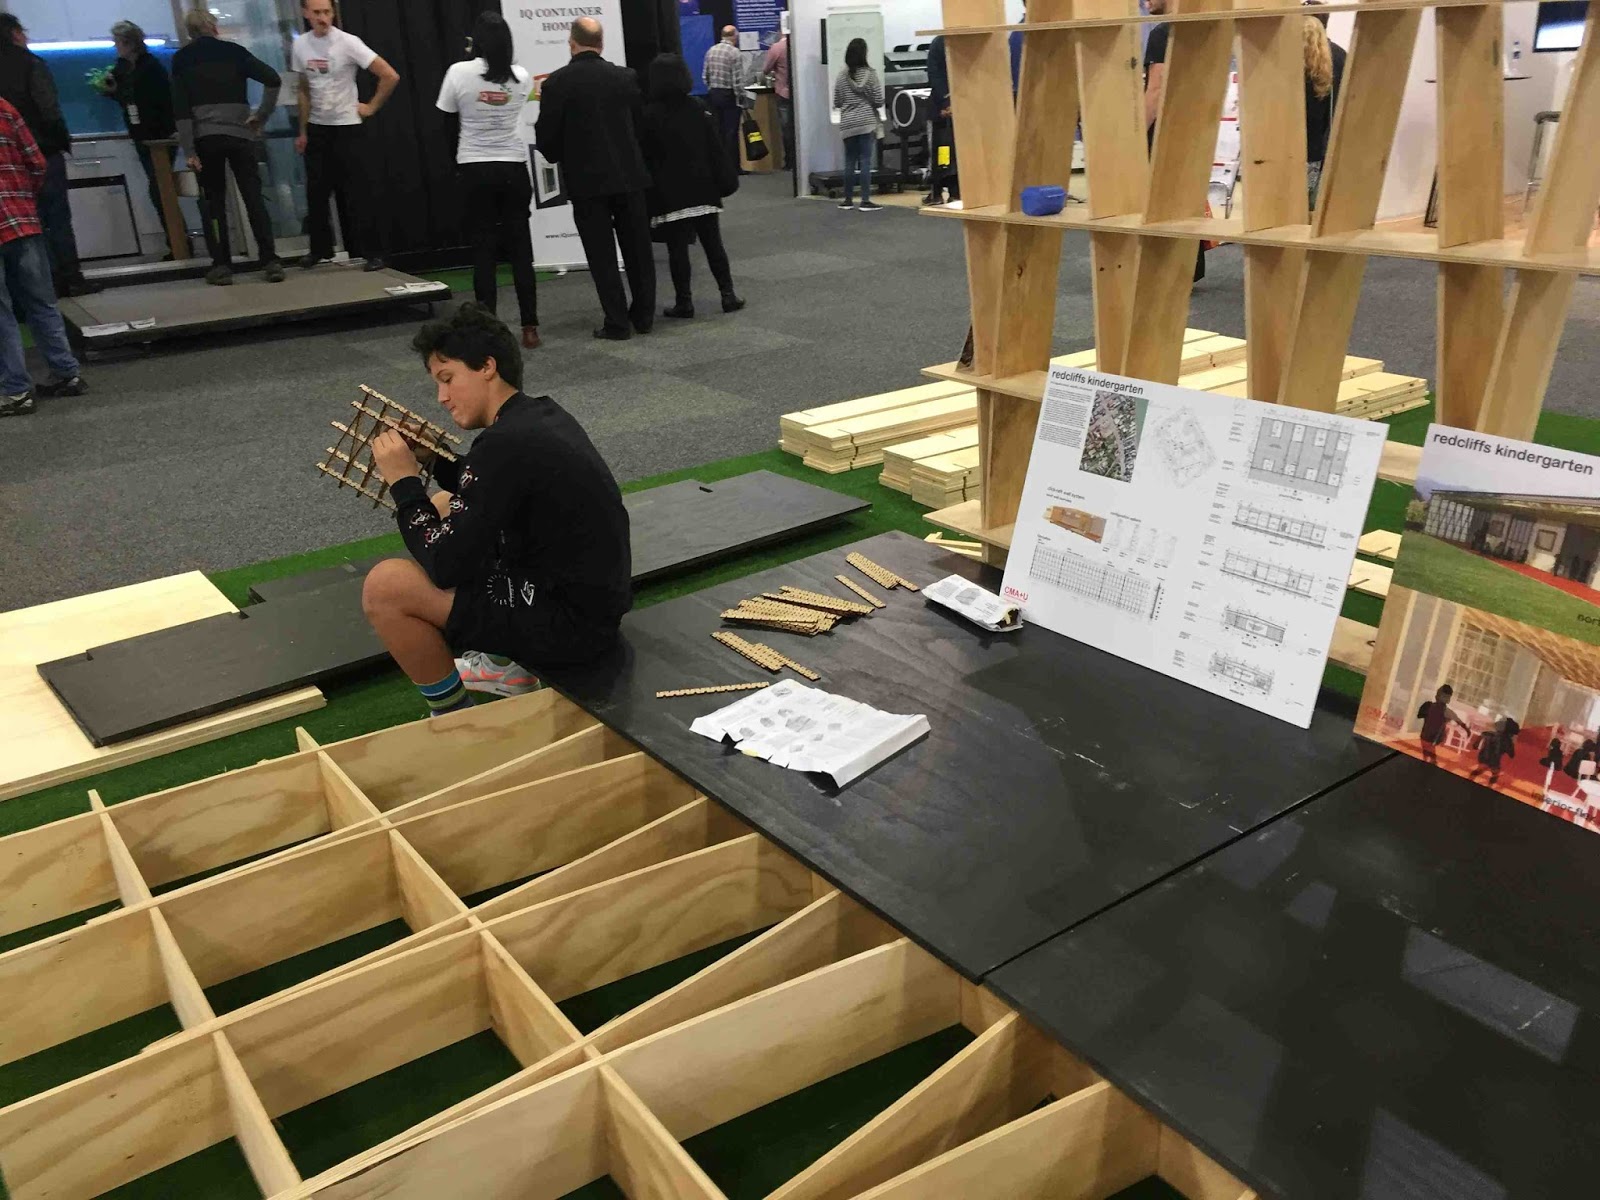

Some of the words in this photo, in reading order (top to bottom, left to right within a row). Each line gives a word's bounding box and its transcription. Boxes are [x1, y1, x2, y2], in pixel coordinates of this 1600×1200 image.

[520, 9, 533, 19] IQ
[535, 6, 603, 18] CONTAINER
[1052, 370, 1086, 384] redcliffs
[1087, 375, 1144, 395] kindergarten
[1433, 433, 1491, 454] redcliffs
[1495, 443, 1593, 475] kindergarten
[1004, 586, 1029, 600] CMA+U
